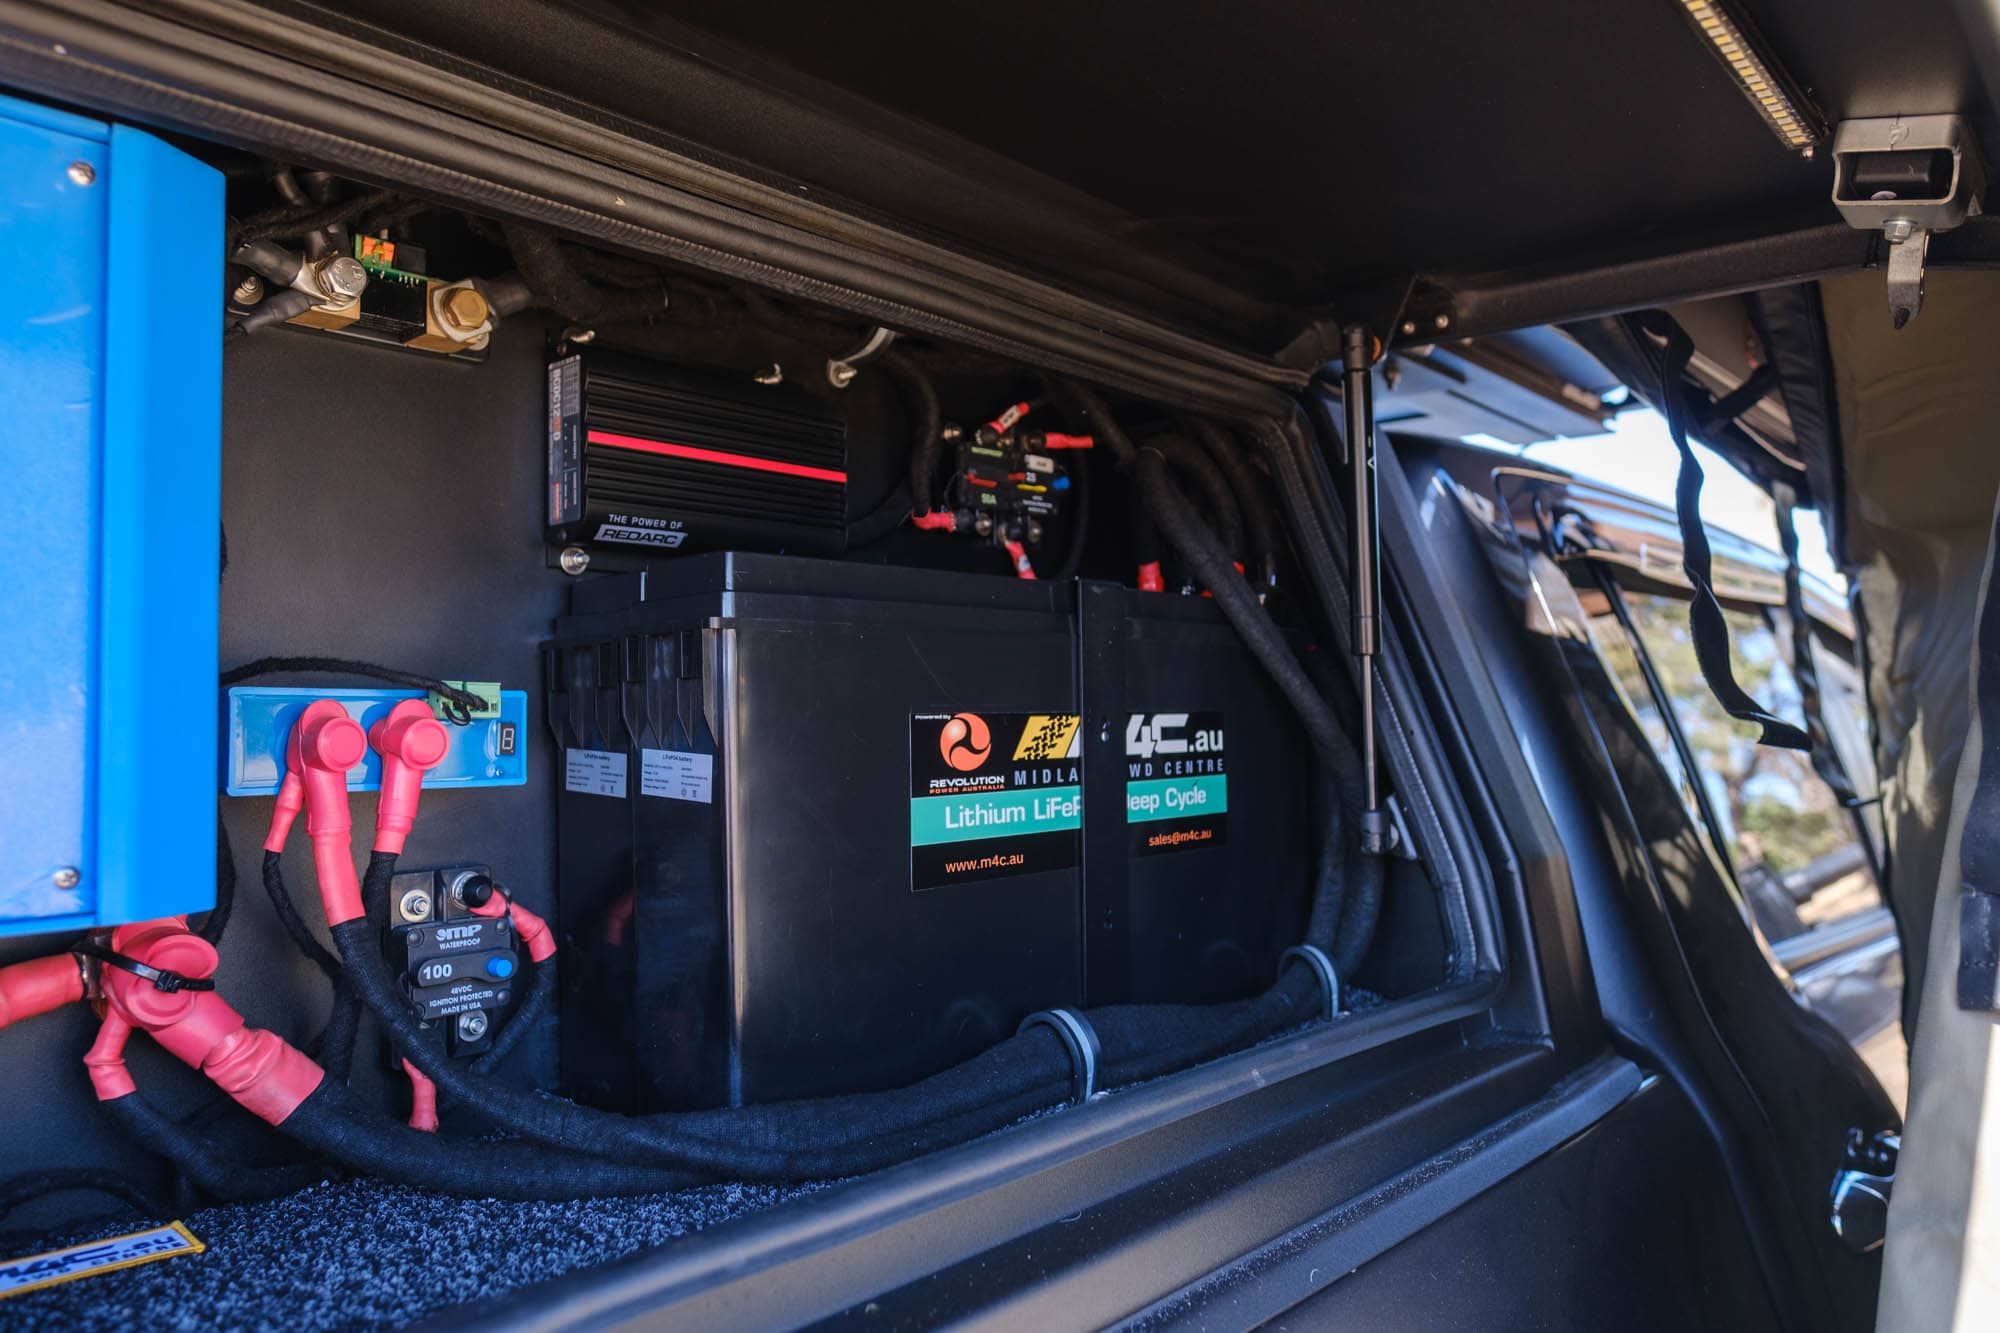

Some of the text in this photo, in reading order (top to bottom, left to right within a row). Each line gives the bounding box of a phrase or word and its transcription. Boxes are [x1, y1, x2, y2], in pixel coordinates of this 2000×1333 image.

[609, 514, 683, 529] THE POWER OF
[602, 528, 678, 545] REDARC
[1164, 759, 1224, 775] CENTRE
[929, 775, 1005, 788] REVOLUTION
[1014, 767, 1079, 786] MIDLA
[961, 783, 1006, 792] AUSTRALIA
[1126, 785, 1207, 814] eep Cycle
[945, 803, 1026, 829] Lithium
[1149, 829, 1212, 847] sales@m4c.au
[945, 853, 1025, 873] www.m4c.au
[439, 937, 481, 950] WATERPROOF
[423, 963, 452, 979] 100
[451, 984, 473, 995] 48VDC
[429, 989, 493, 1008] IGNITION PROTECTED
[441, 1001, 482, 1016] MADE IN USA
